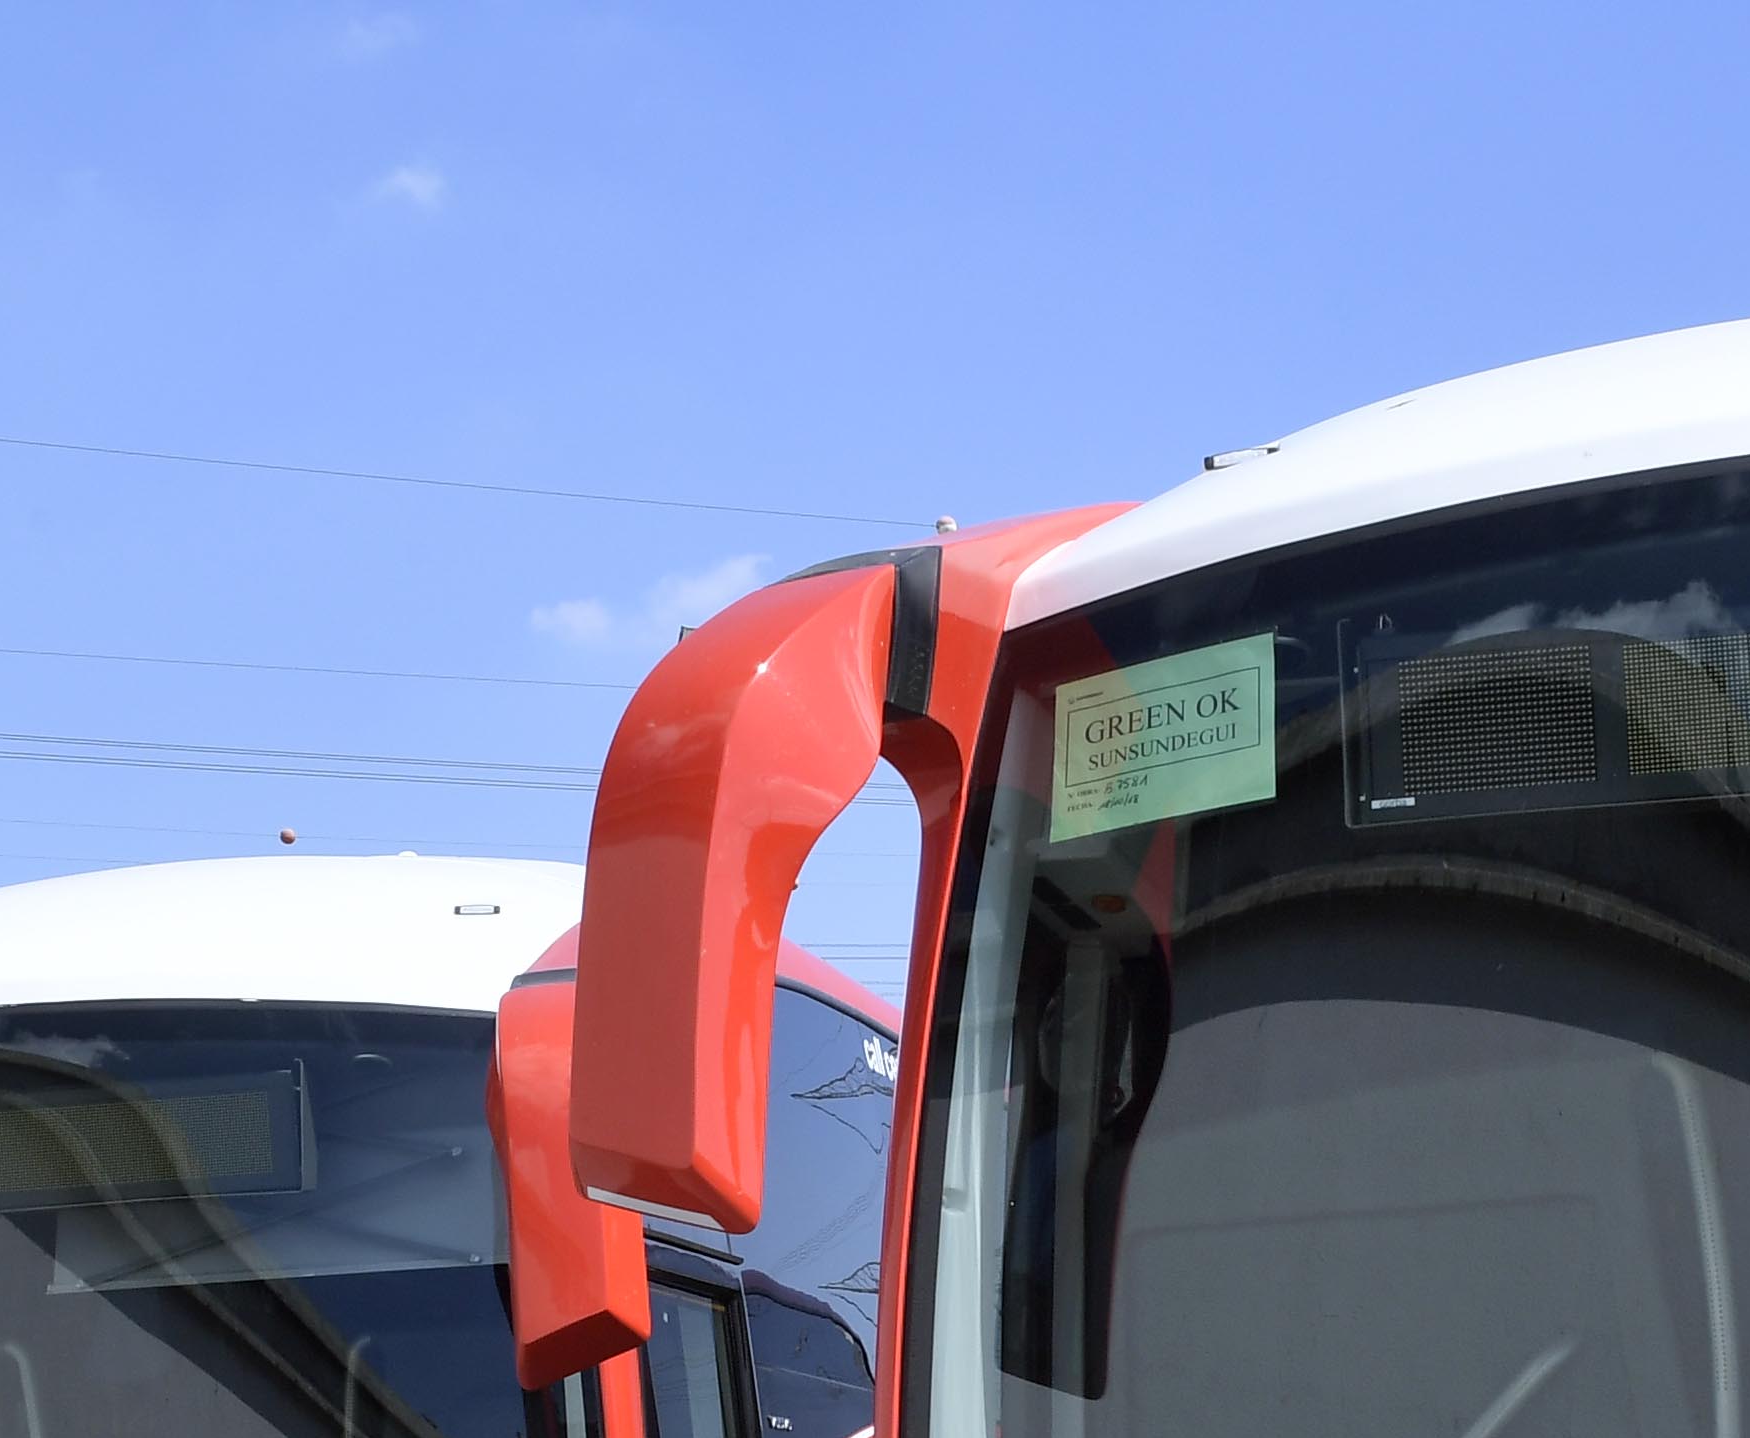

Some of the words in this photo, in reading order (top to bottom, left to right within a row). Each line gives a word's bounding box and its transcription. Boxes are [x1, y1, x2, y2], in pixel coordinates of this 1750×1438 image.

[1084, 699, 1186, 744] GREEN
[1196, 687, 1241, 718] OK
[1088, 723, 1237, 771] SUNSUNDEGUI
